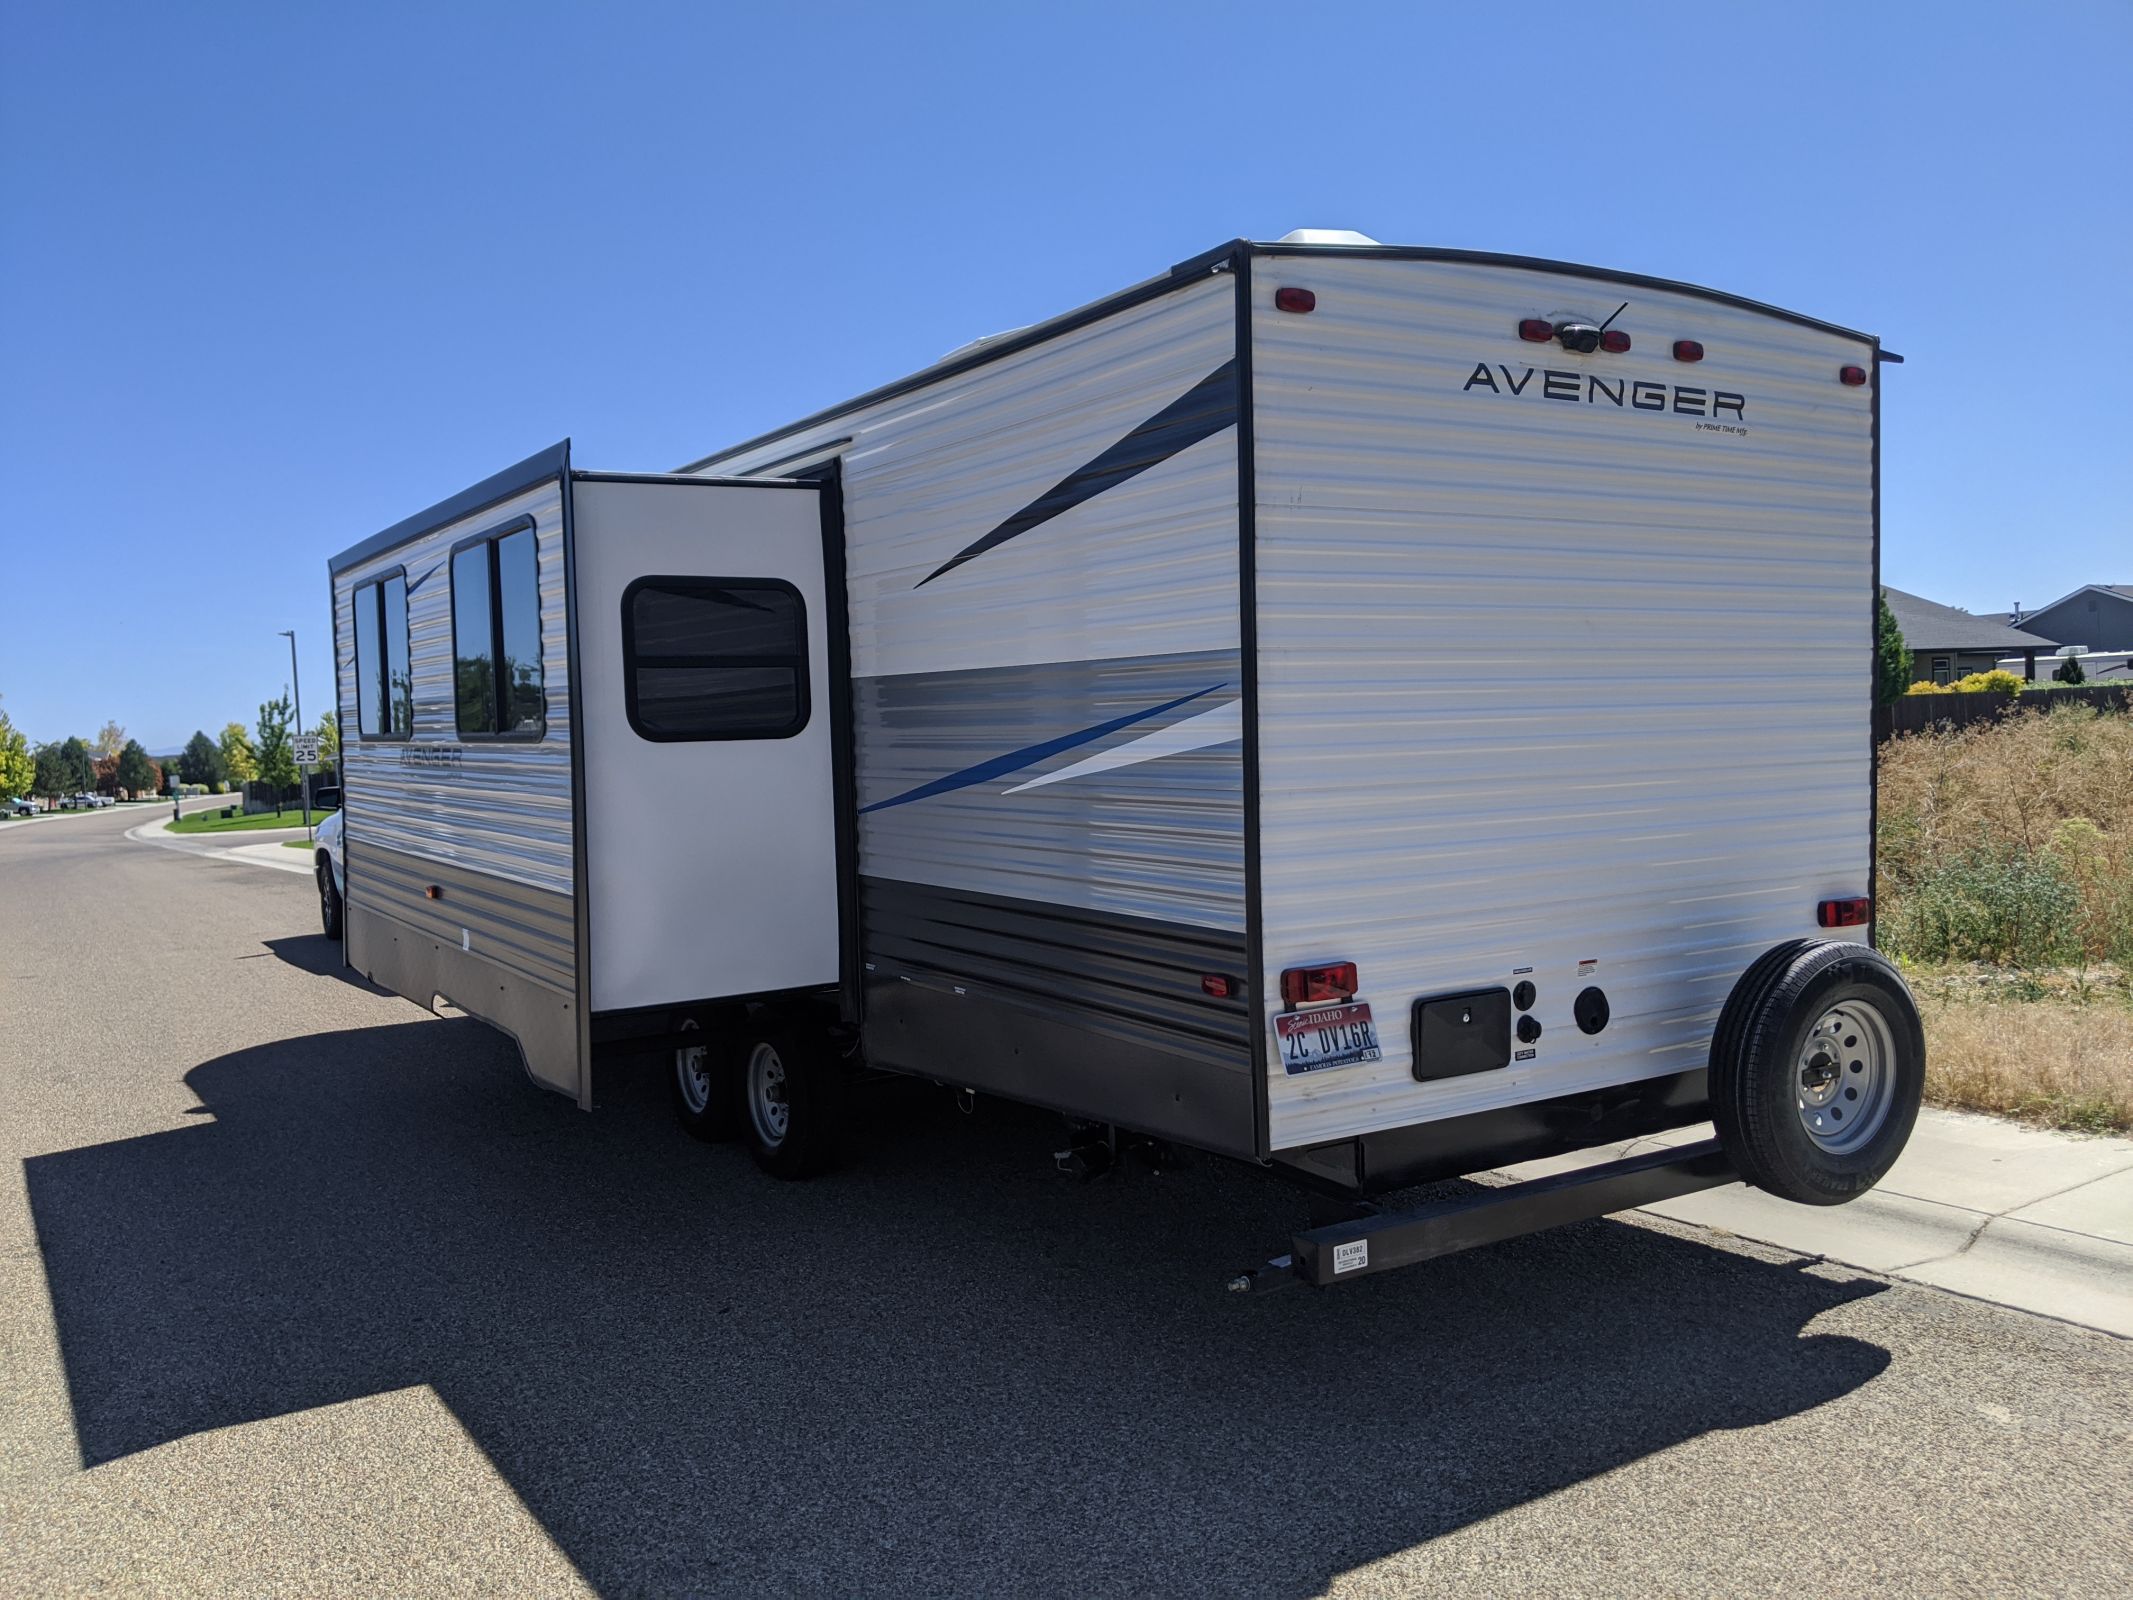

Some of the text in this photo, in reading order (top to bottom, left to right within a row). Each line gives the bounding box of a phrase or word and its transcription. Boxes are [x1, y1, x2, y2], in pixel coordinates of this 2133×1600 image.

[1463, 362, 1746, 421] AVENGER
[1703, 423, 1721, 432] PRIME
[1722, 425, 1736, 434] TIME
[296, 750, 317, 762] 25
[401, 747, 463, 768] AVENGER
[1287, 1009, 1343, 1032] Scenic IDAHO
[1286, 1020, 1374, 1060] 2C DV16R
[1310, 1062, 1333, 1071] FAMOUS
[1358, 1255, 1366, 1266] 20
